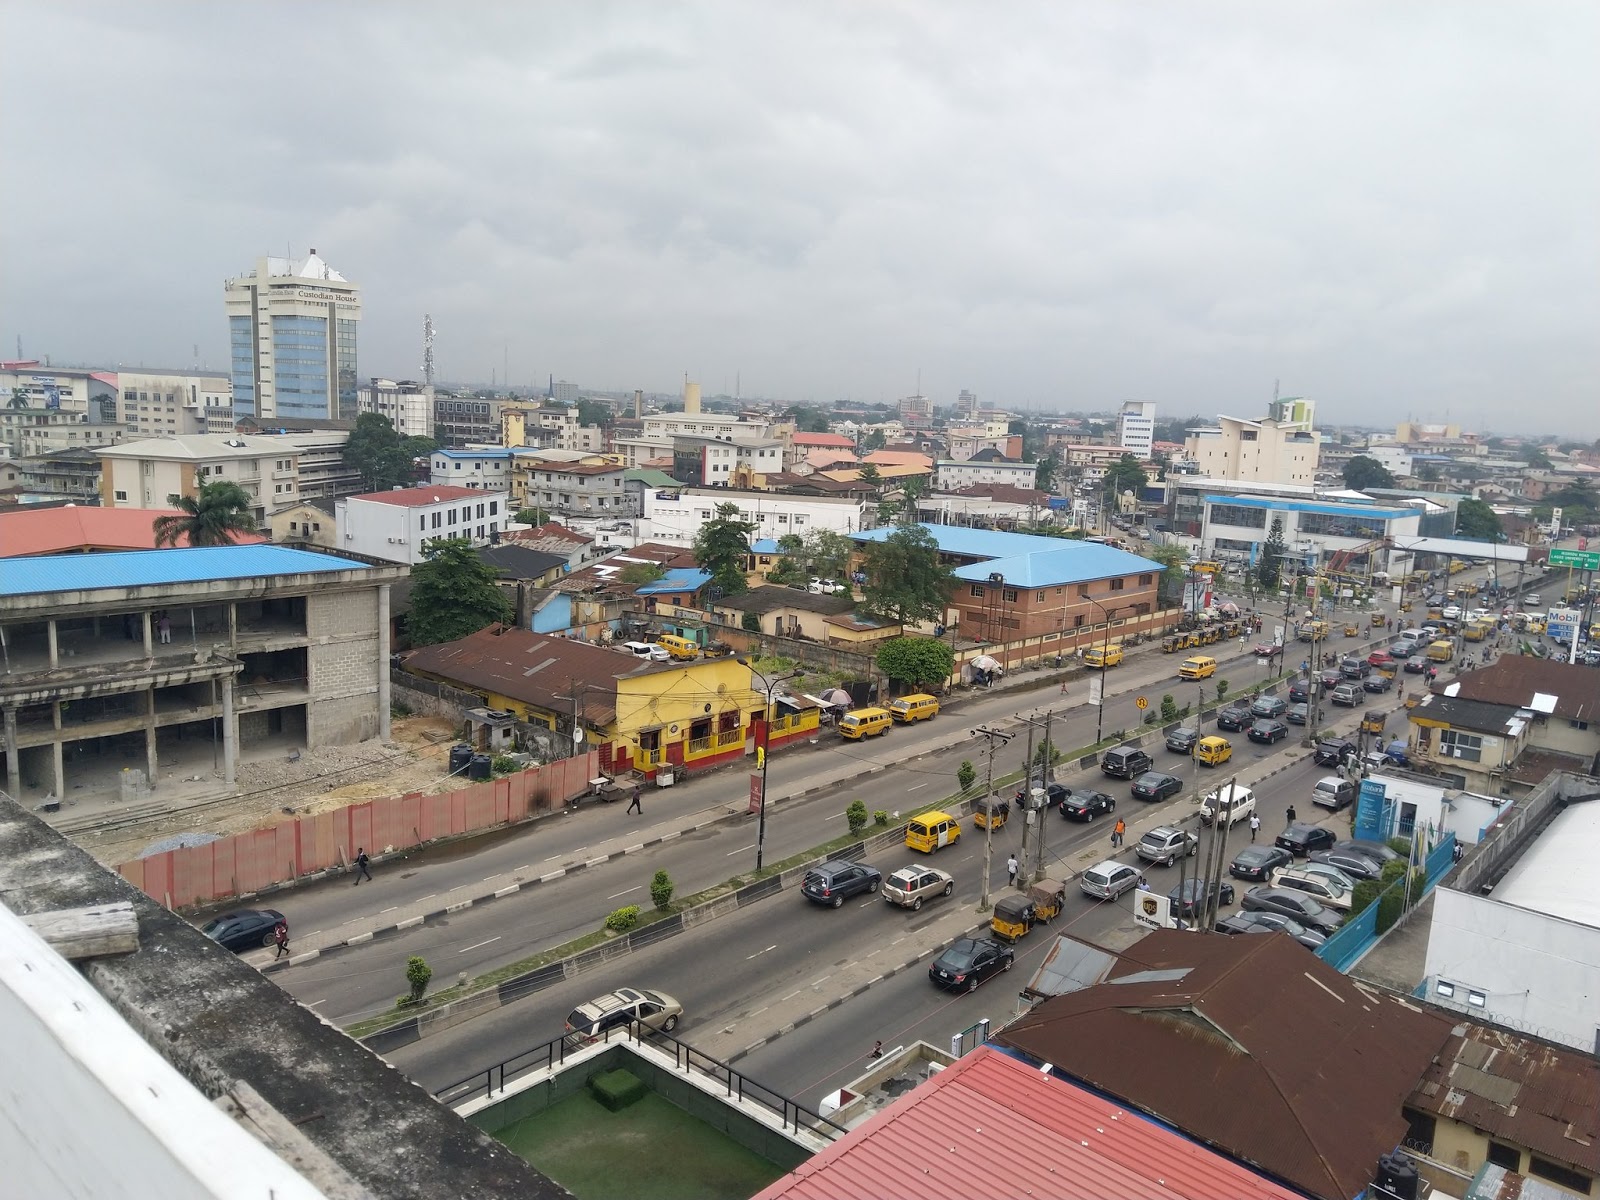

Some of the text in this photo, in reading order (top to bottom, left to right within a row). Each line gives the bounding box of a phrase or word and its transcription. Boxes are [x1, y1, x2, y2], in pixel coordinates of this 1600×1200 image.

[298, 290, 334, 300] Custodian
[335, 294, 357, 303] House
[1549, 612, 1579, 623] Mobil
[1361, 783, 1384, 794] Ecobank
[1143, 902, 1157, 913] ups
